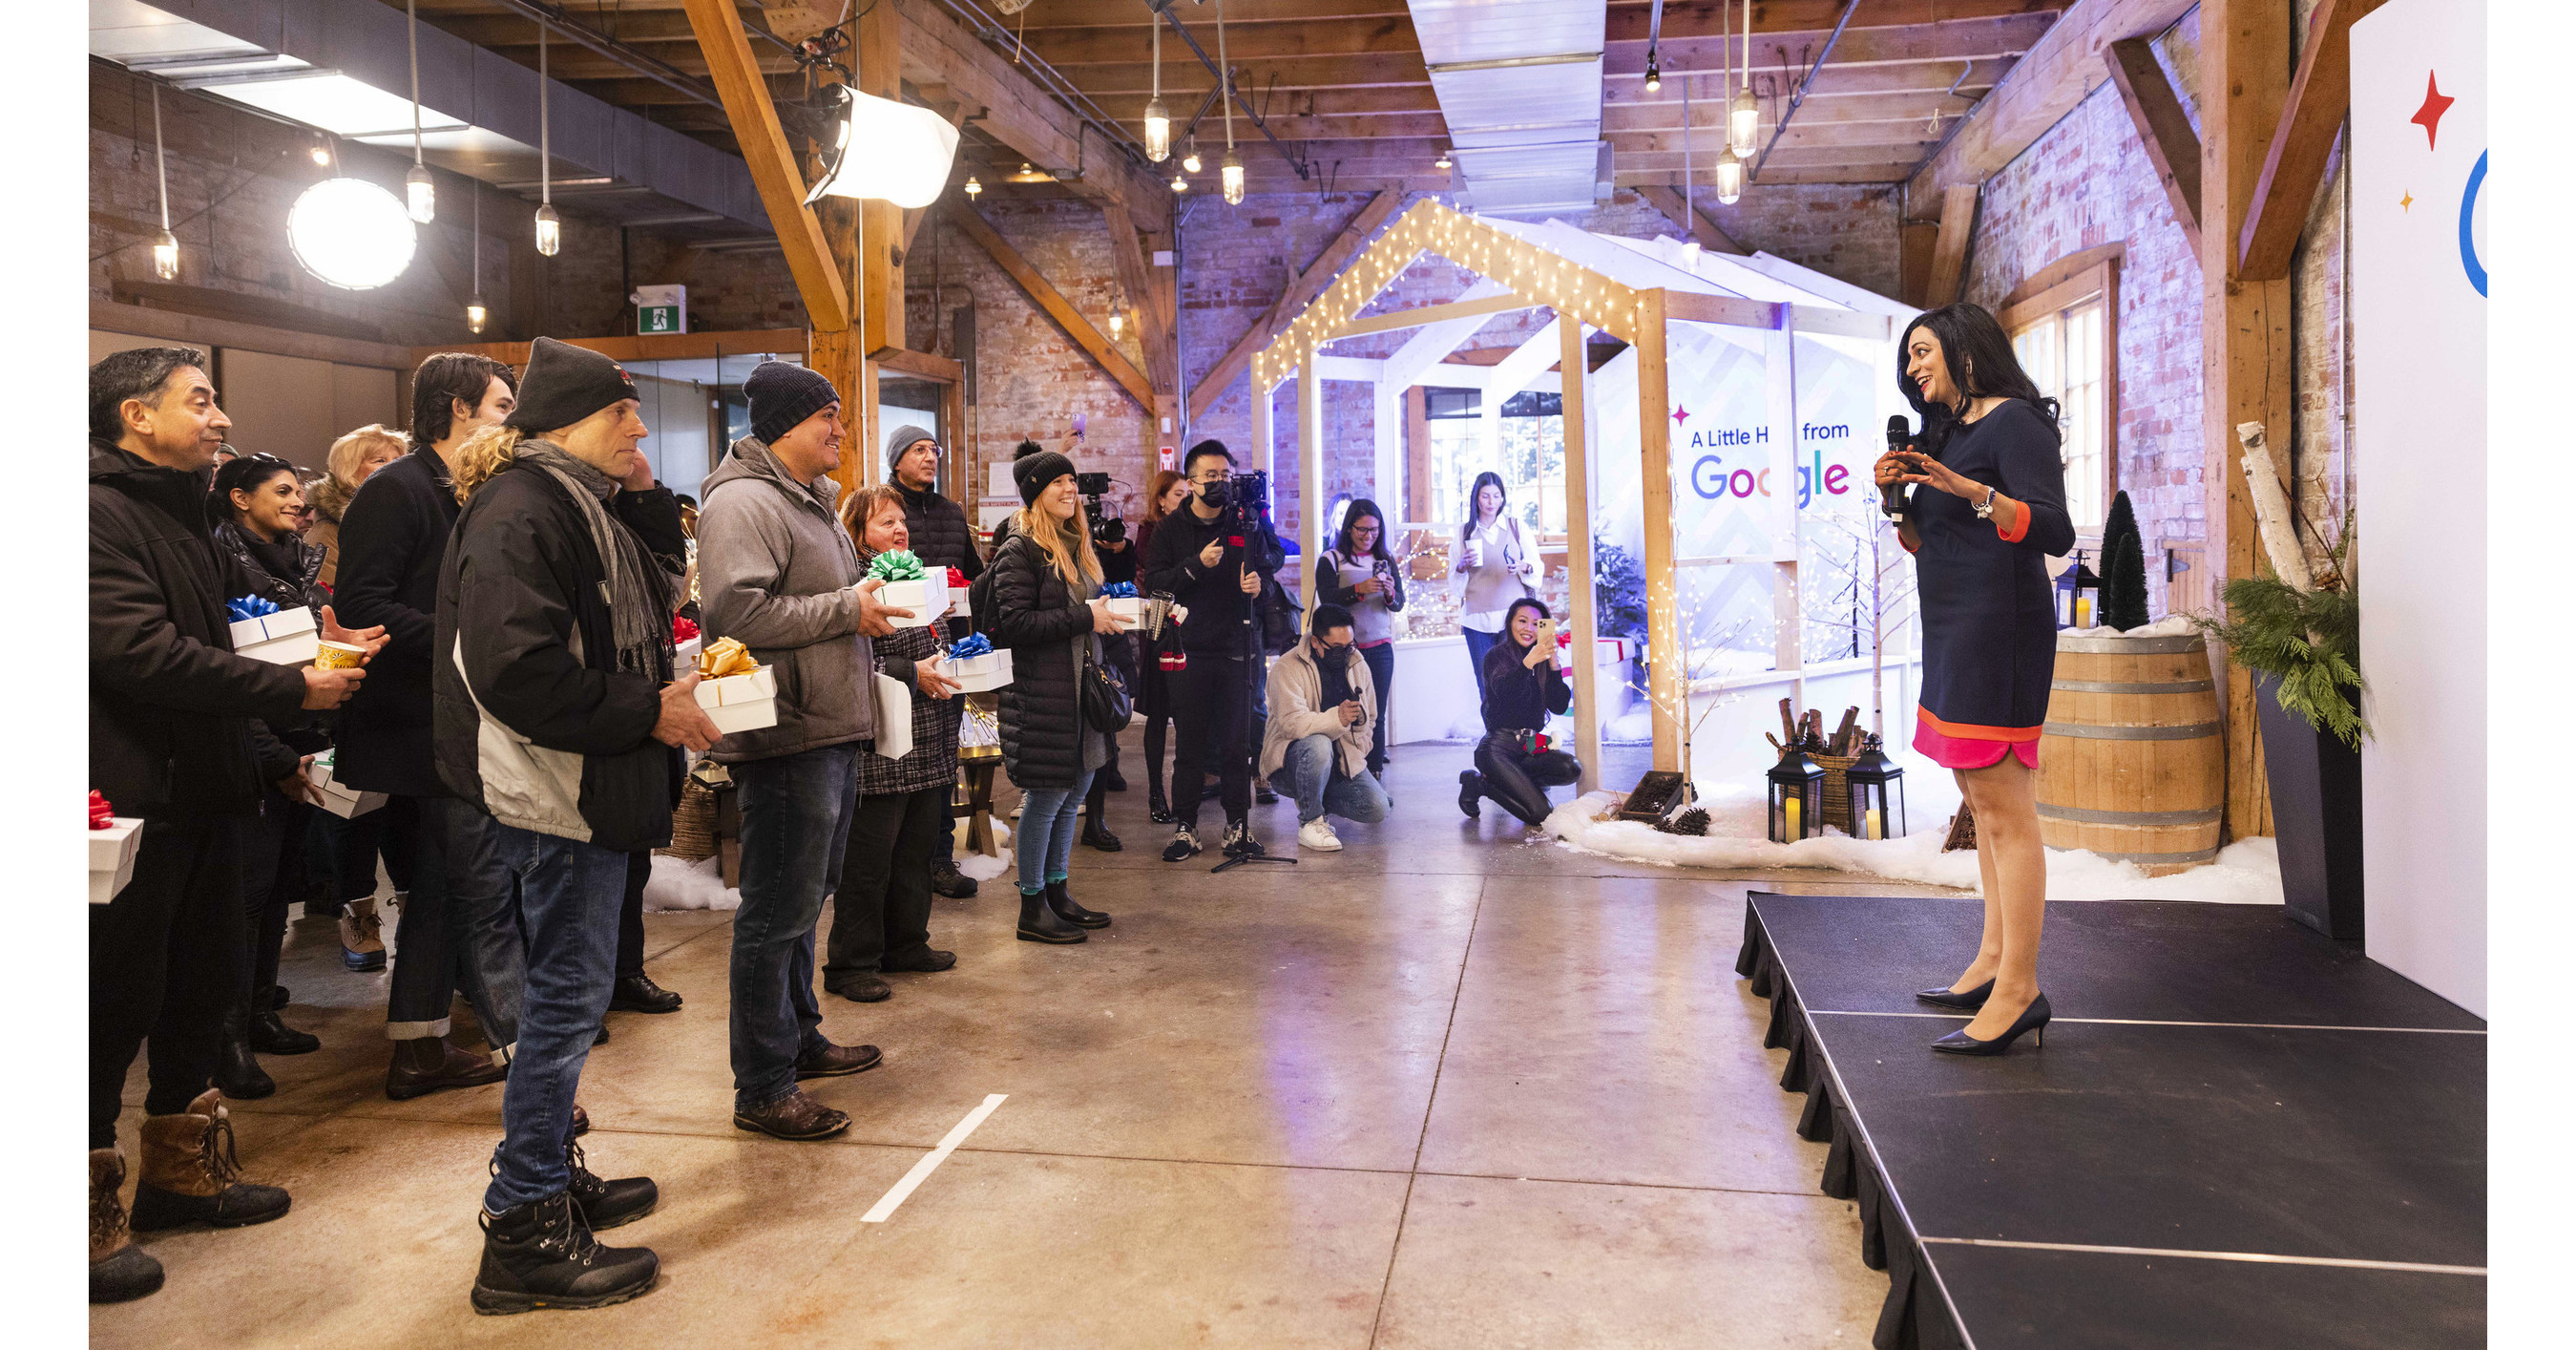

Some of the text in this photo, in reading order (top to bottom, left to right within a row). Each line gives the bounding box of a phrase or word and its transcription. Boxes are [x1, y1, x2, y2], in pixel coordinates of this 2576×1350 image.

[1691, 432, 1703, 448] A
[1708, 428, 1750, 447] Little
[1803, 422, 1849, 440] from
